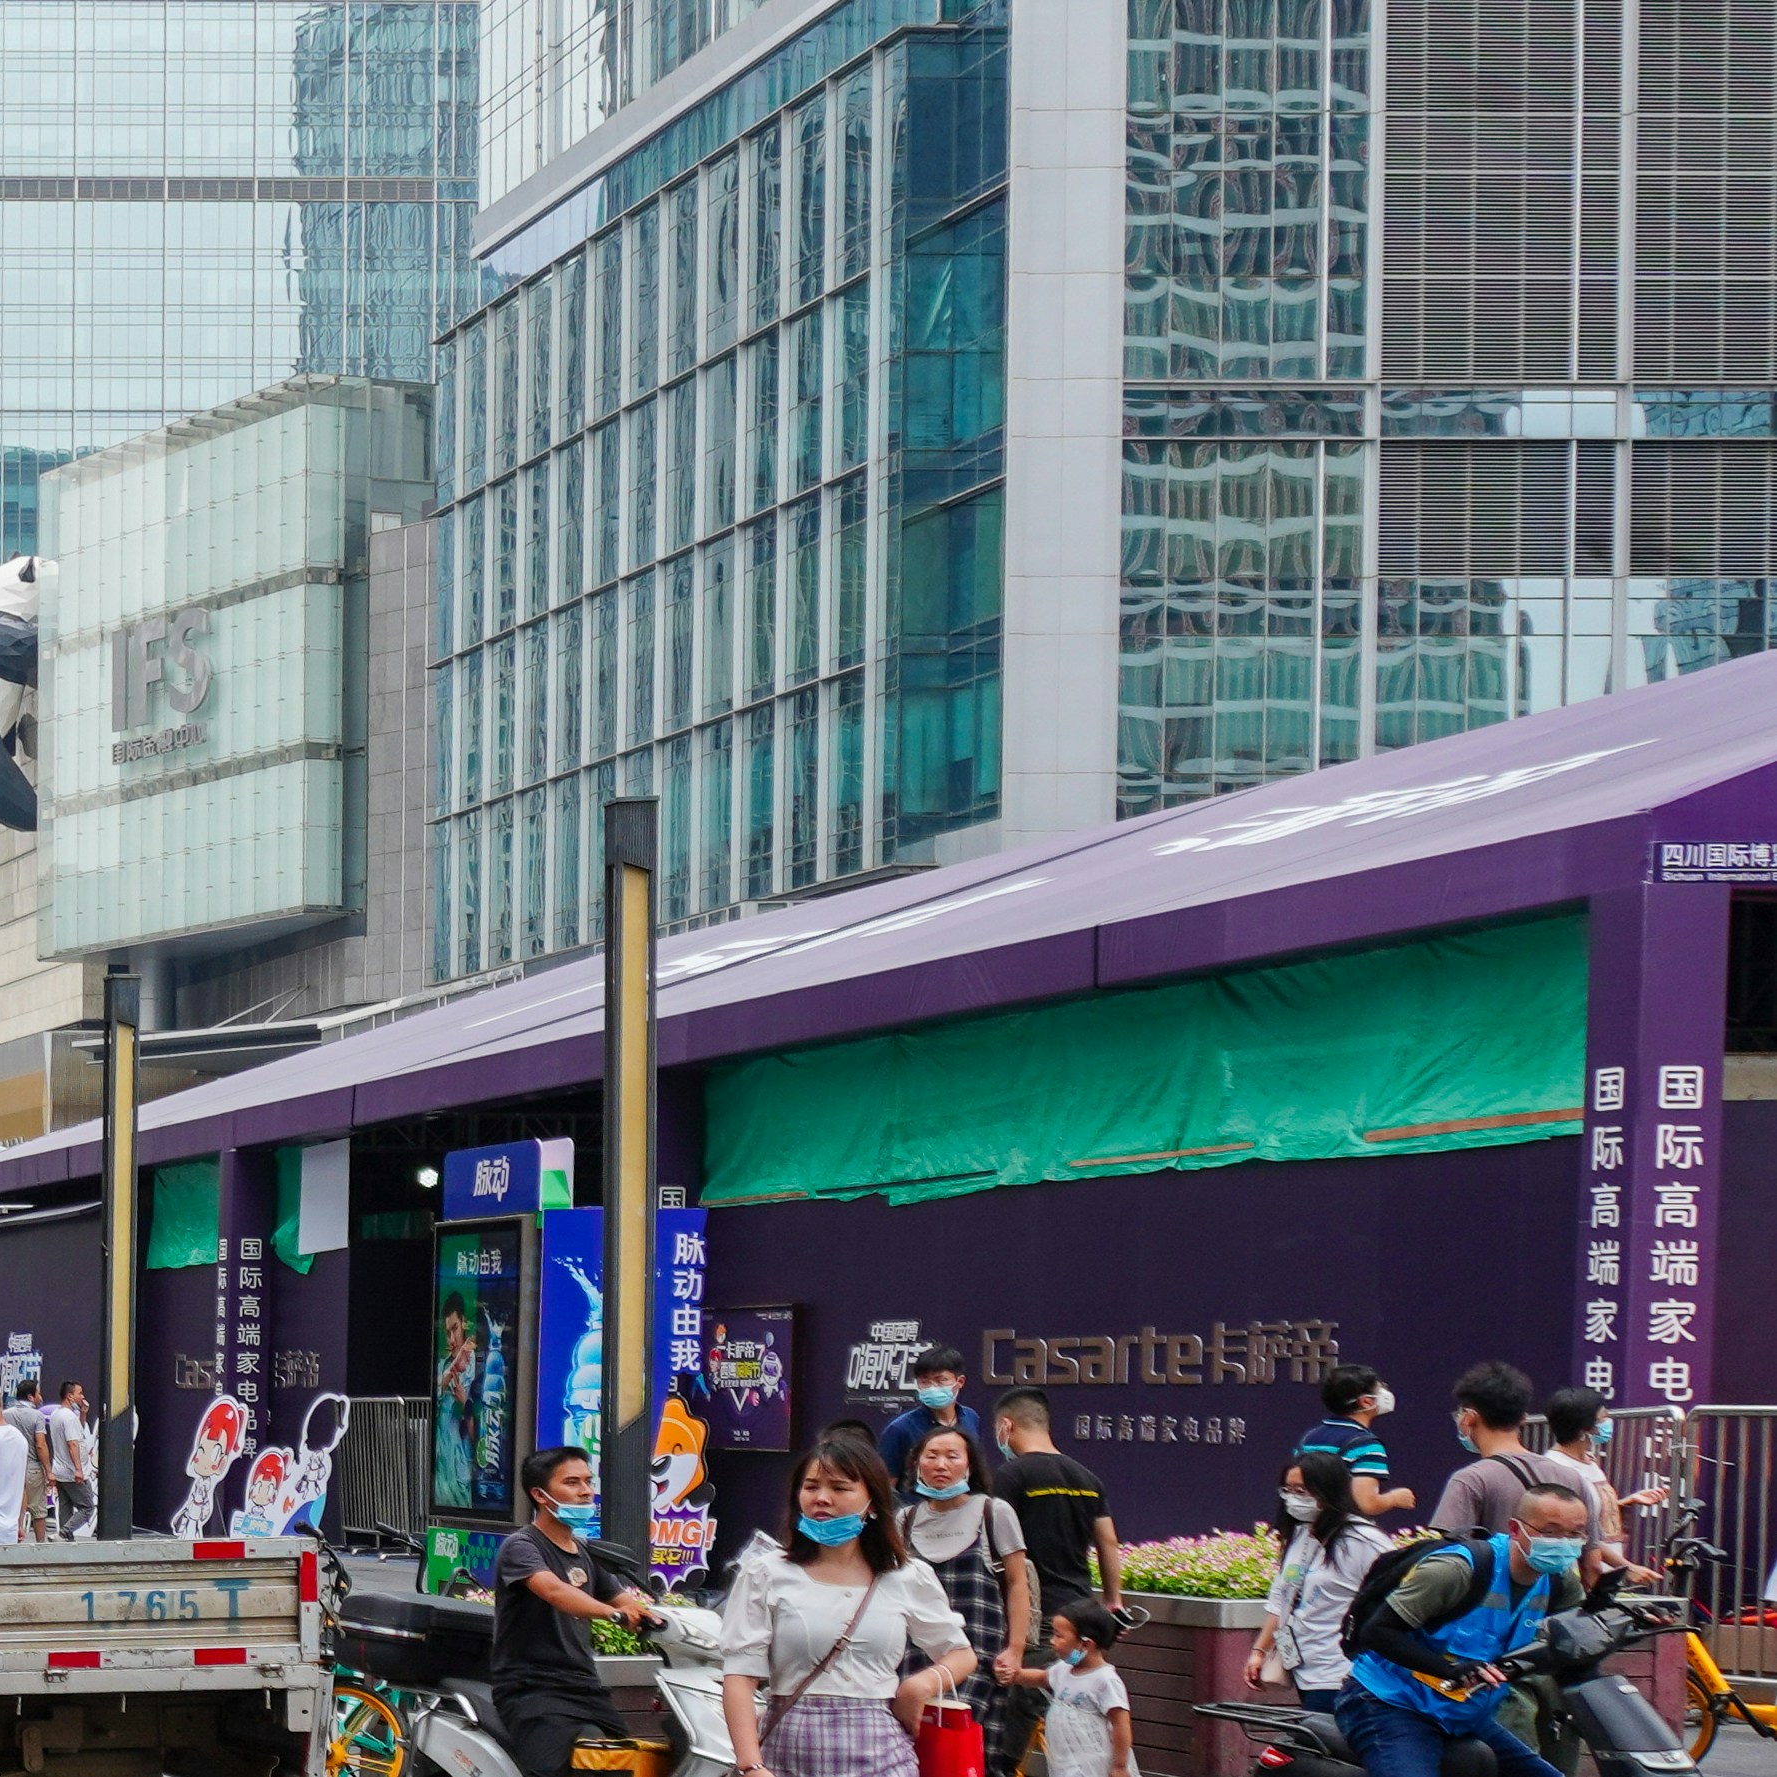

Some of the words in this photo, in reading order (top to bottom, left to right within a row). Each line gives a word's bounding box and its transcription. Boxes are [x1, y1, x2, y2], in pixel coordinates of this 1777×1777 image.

[111, 606, 210, 733] IFS
[473, 1155, 510, 1202] 脉动
[456, 1248, 503, 1276] 脉动由我
[669, 1232, 707, 1372] 脉动由我
[982, 1326, 1204, 1386] Casarte
[1204, 1318, 1340, 1386] 卡萨帝
